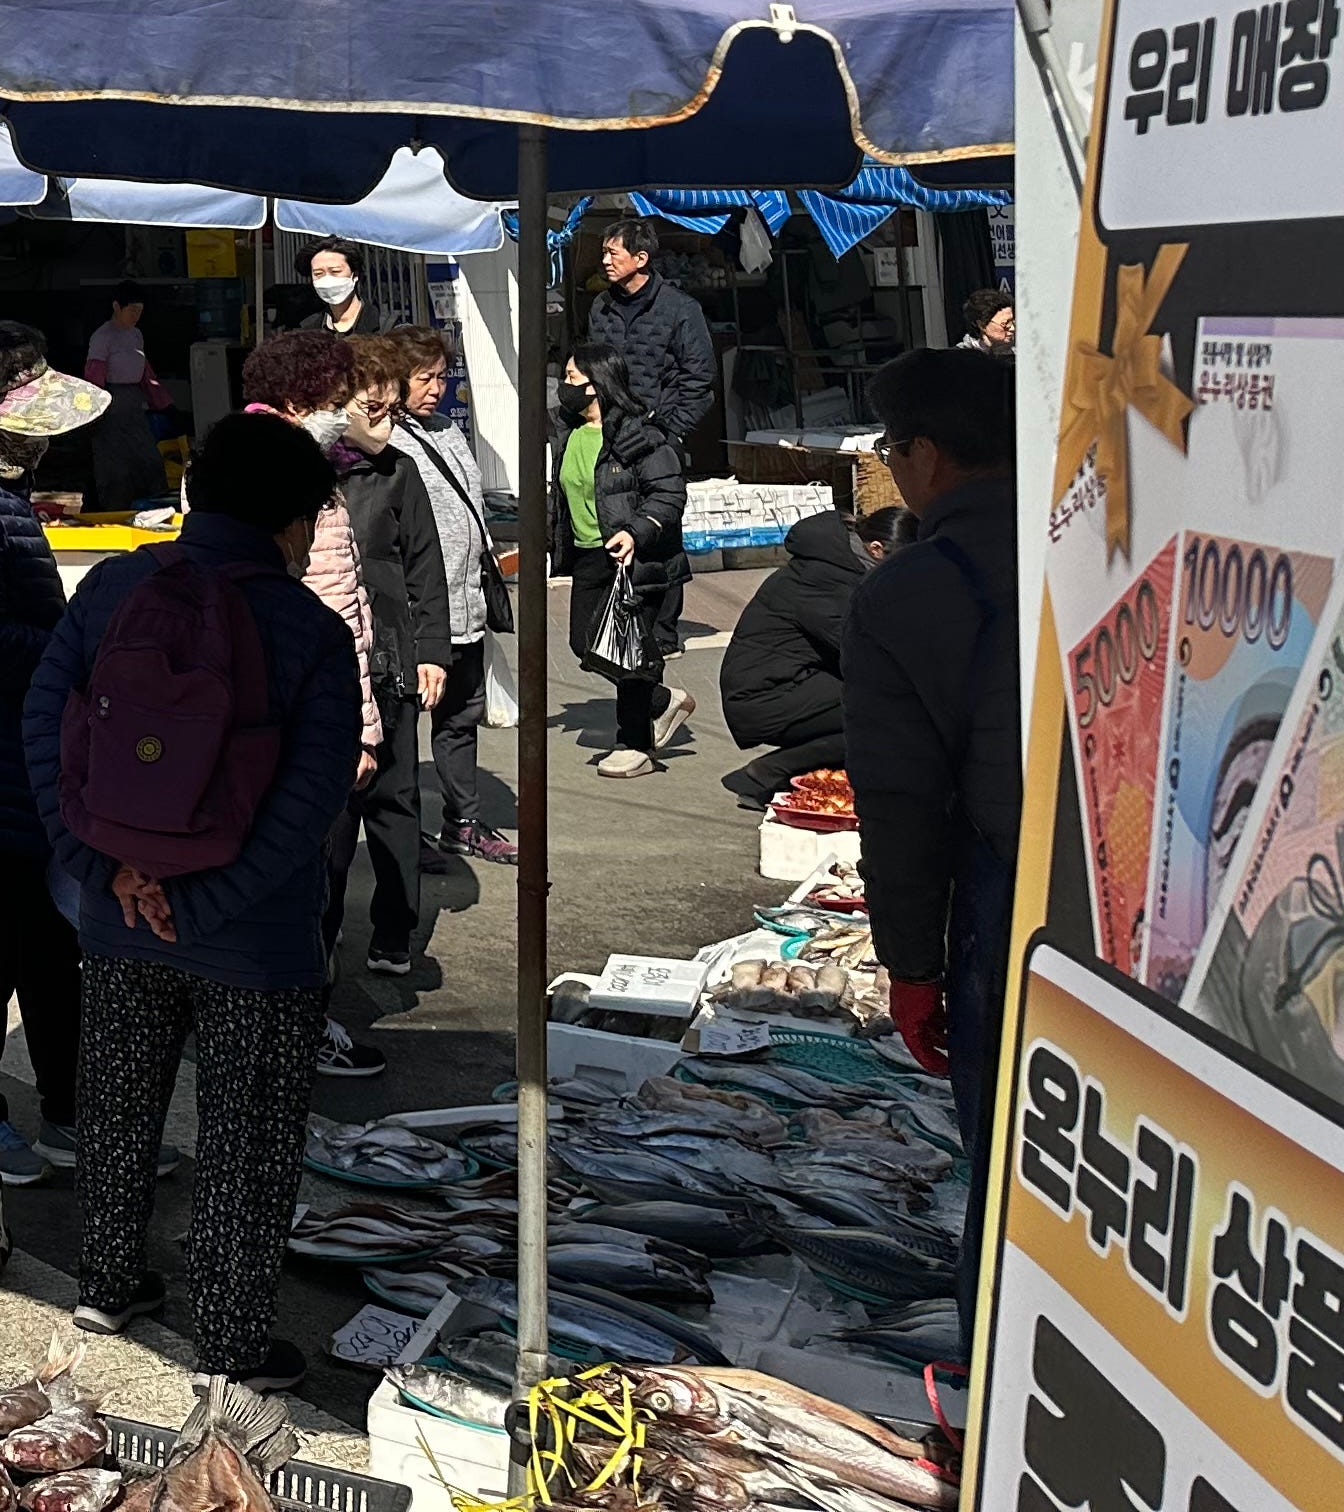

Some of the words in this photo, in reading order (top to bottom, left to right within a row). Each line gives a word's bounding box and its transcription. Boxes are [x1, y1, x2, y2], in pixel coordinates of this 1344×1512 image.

[1124, 16, 1216, 136] 우리
[1074, 577, 1160, 730] 5000
[1183, 535, 1293, 652] 10000
[1020, 1044, 1198, 1314] 온누리
